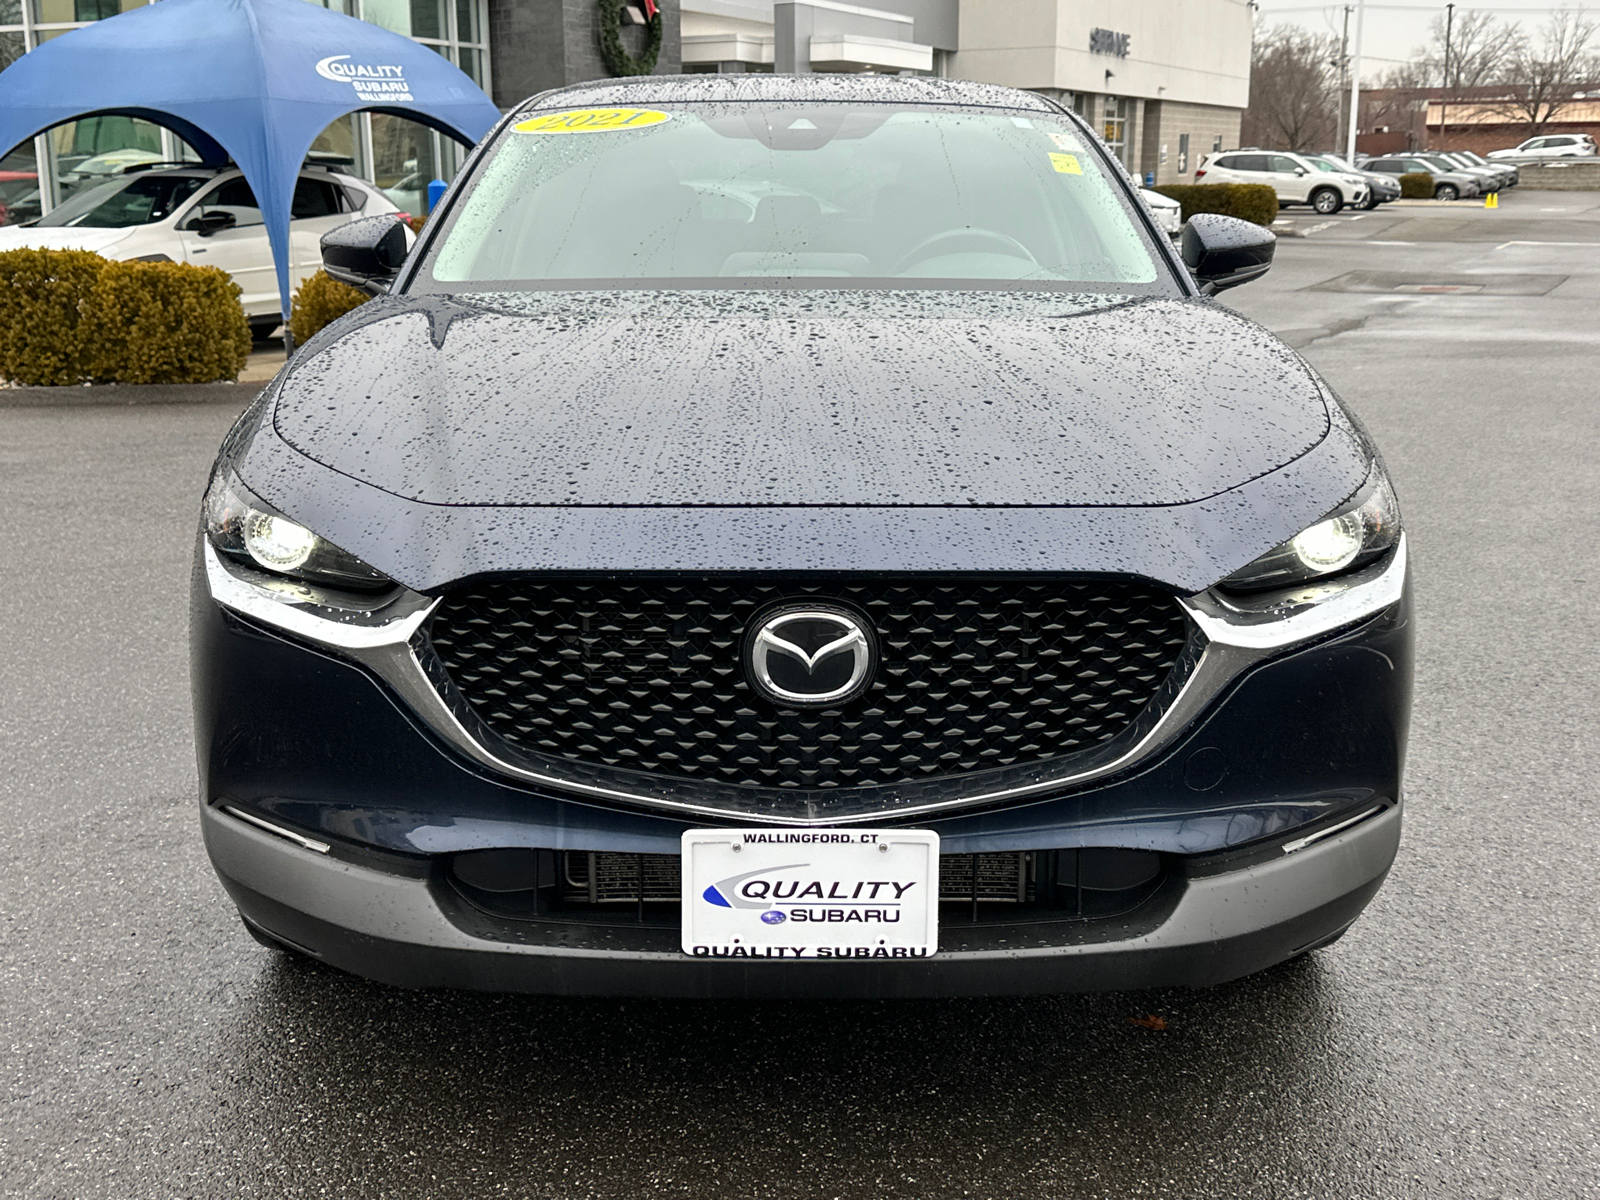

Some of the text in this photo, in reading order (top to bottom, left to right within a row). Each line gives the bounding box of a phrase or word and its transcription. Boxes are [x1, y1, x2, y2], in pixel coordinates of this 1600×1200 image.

[329, 63, 403, 77] QUALITY
[352, 81, 409, 92] SUBARU
[535, 112, 646, 131] 2021
[743, 833, 879, 844] WALLINGFORD, CT
[741, 880, 918, 900] QUALITY
[789, 909, 901, 923] SUBARU
[692, 945, 927, 958] QUALITY SUBARU
